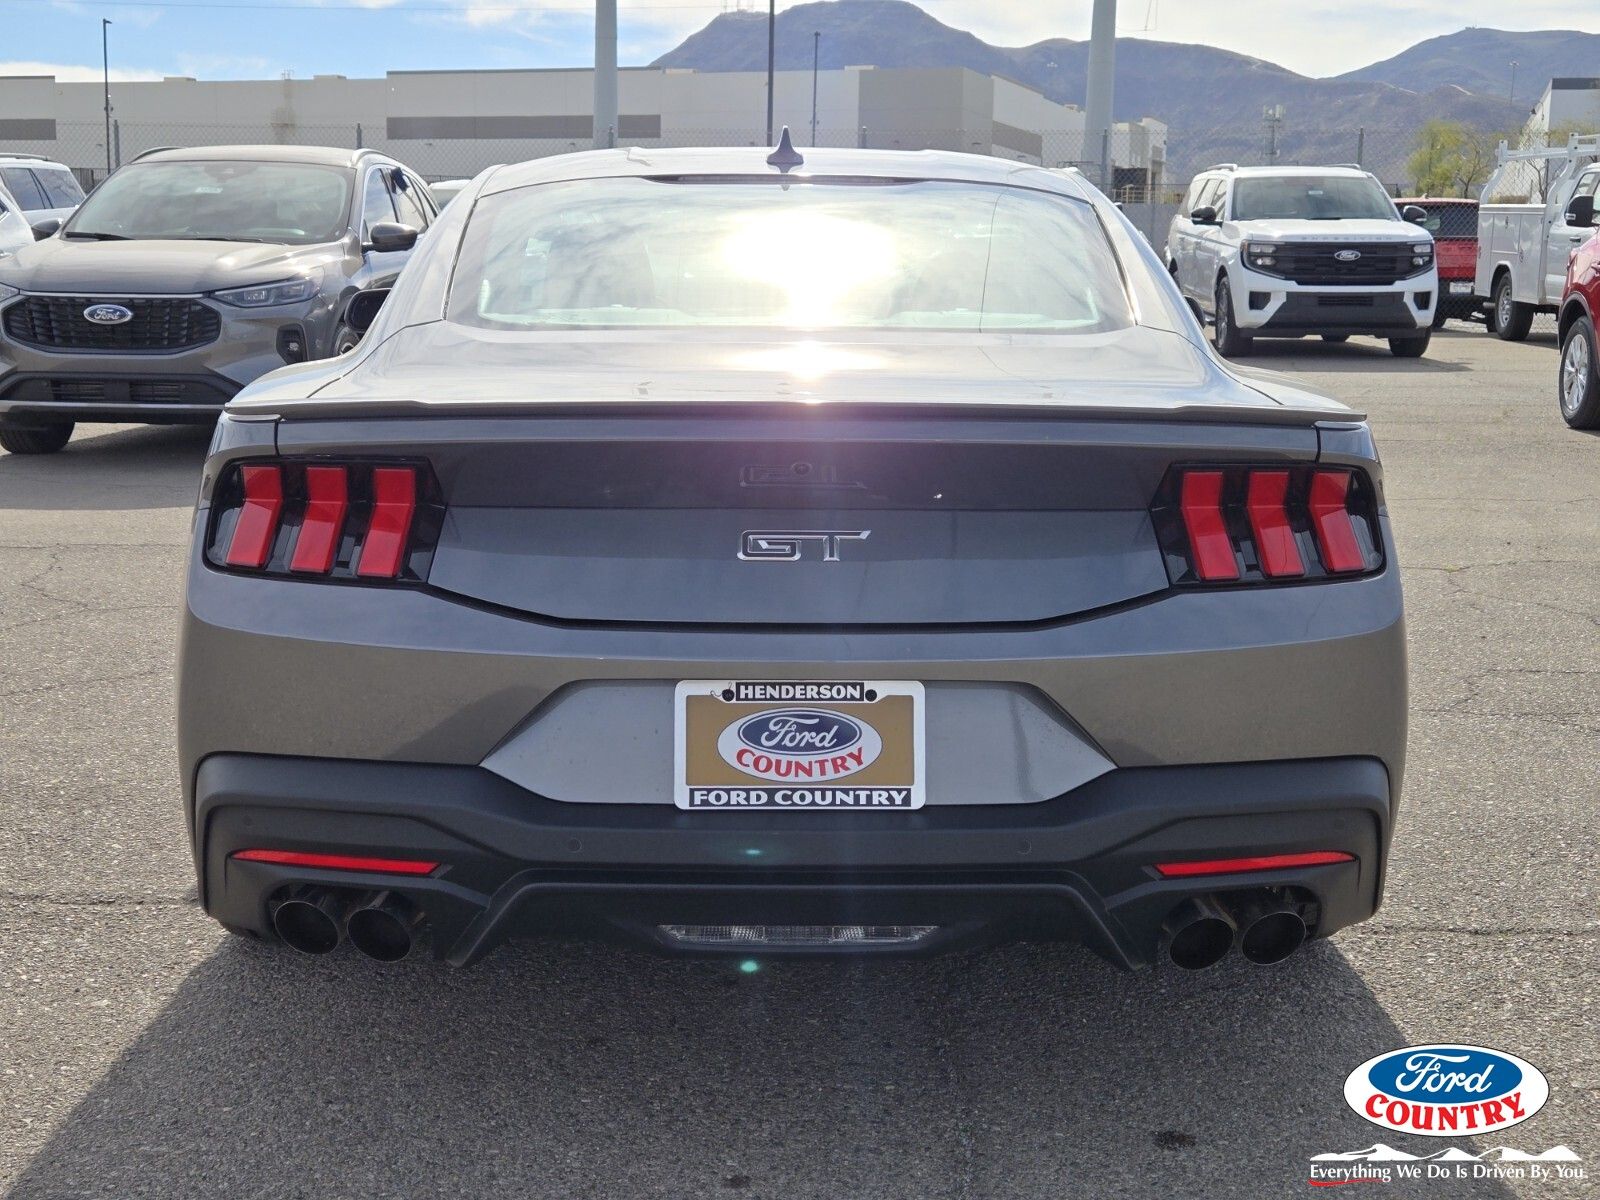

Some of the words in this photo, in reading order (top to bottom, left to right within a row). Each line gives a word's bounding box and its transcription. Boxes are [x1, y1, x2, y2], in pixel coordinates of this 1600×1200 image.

[94, 308, 120, 320] Ford
[737, 529, 871, 562] GT
[739, 685, 861, 699] HENDERSON
[760, 716, 838, 748] Ford
[736, 747, 864, 778] COUNTRY
[693, 790, 768, 805] FORD
[774, 790, 906, 805] COUNTRY
